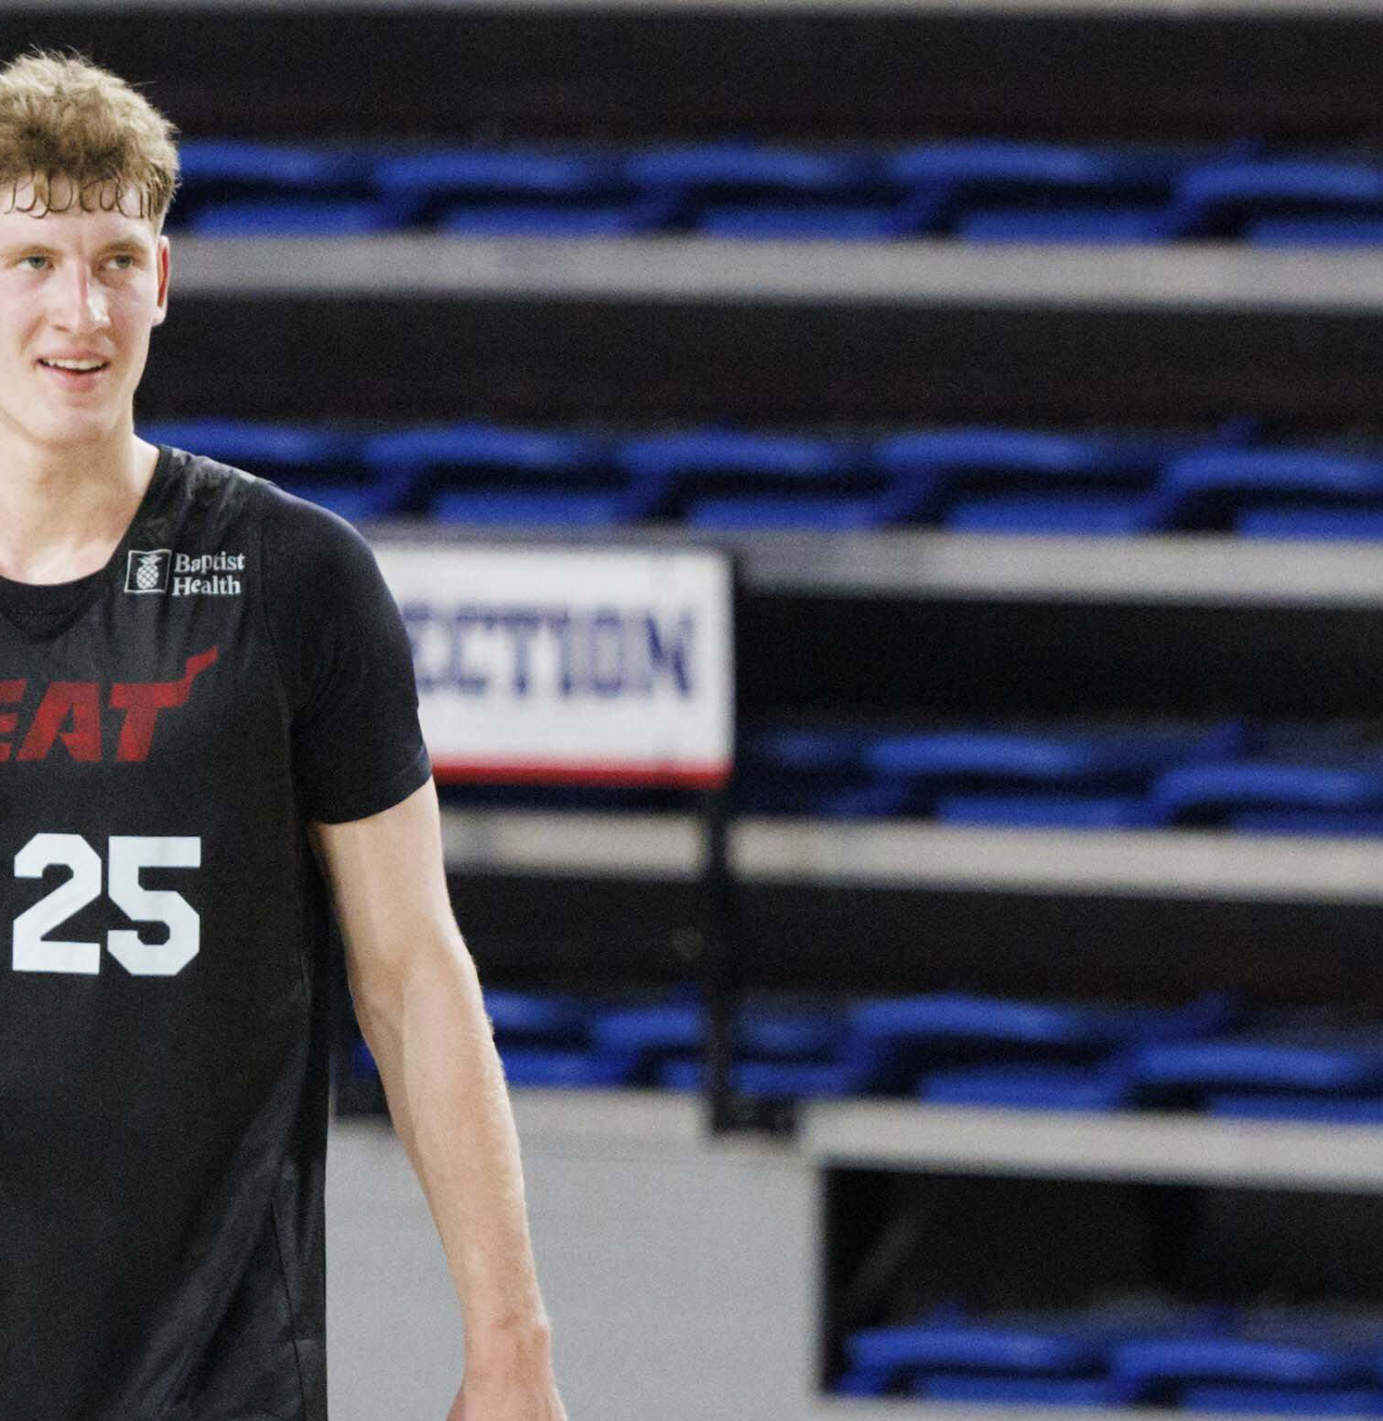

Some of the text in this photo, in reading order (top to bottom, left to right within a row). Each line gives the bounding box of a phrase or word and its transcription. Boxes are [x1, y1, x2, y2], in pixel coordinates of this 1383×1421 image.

[174, 551, 246, 574] Baptist
[171, 575, 241, 596] Health
[12, 833, 201, 977] 25
